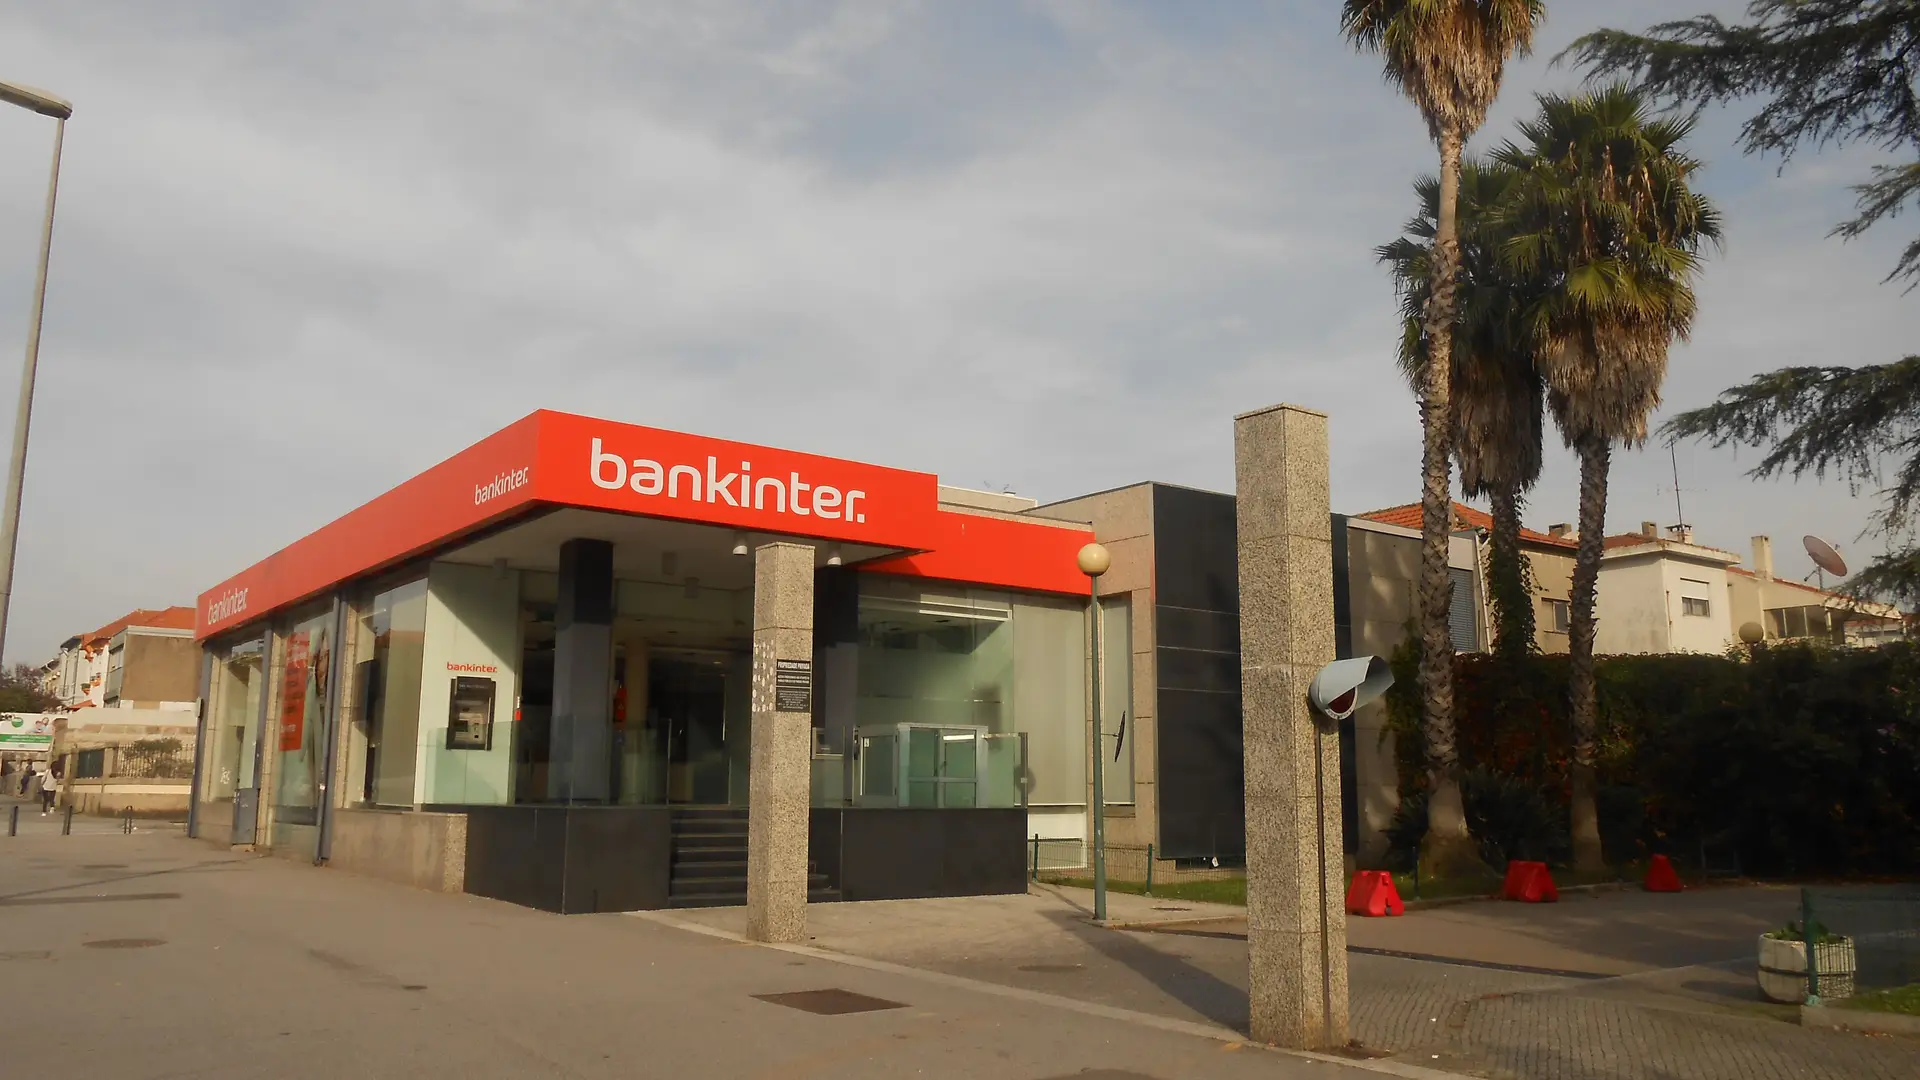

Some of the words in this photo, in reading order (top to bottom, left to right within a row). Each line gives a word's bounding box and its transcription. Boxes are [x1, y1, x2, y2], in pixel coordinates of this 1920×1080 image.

[474, 466, 529, 506] bankinter.
[590, 437, 866, 524] bankinter.
[446, 661, 498, 674] bankinter.
